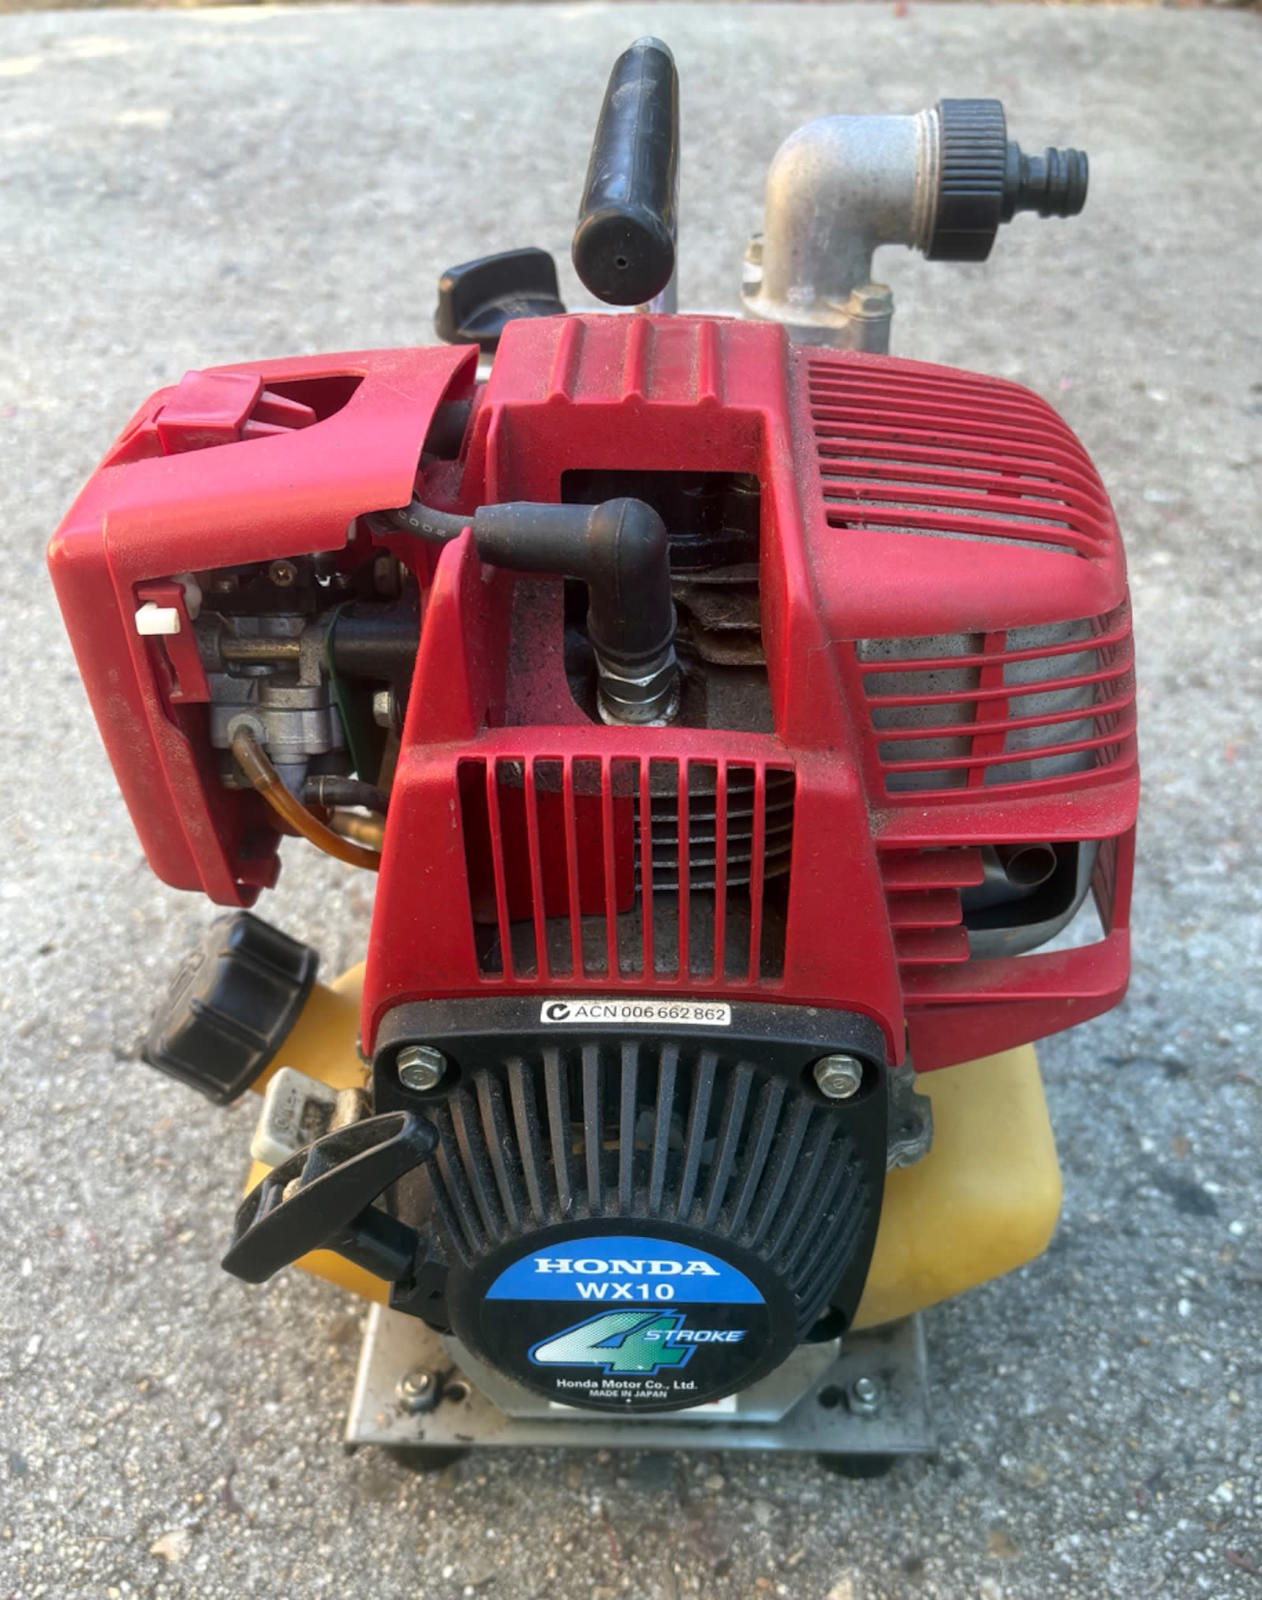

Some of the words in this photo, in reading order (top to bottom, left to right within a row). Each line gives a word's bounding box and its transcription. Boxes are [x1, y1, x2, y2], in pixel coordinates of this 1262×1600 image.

[574, 1005, 617, 1018] ACN
[621, 1006, 654, 1018] 006
[657, 1007, 689, 1019] 662
[694, 1008, 725, 1021] 862
[534, 1258, 720, 1276] HONDA
[576, 1282, 675, 1300] WX10
[528, 1309, 697, 1375] 4
[644, 1329, 748, 1343] STROKE
[556, 1378, 599, 1389] Honda
[602, 1379, 642, 1390] Motor
[645, 1380, 670, 1391] Co.,
[673, 1380, 698, 1391] Ltd.
[589, 1389, 618, 1398] MADE
[621, 1390, 632, 1398] IN
[634, 1390, 668, 1399] JAPAN
